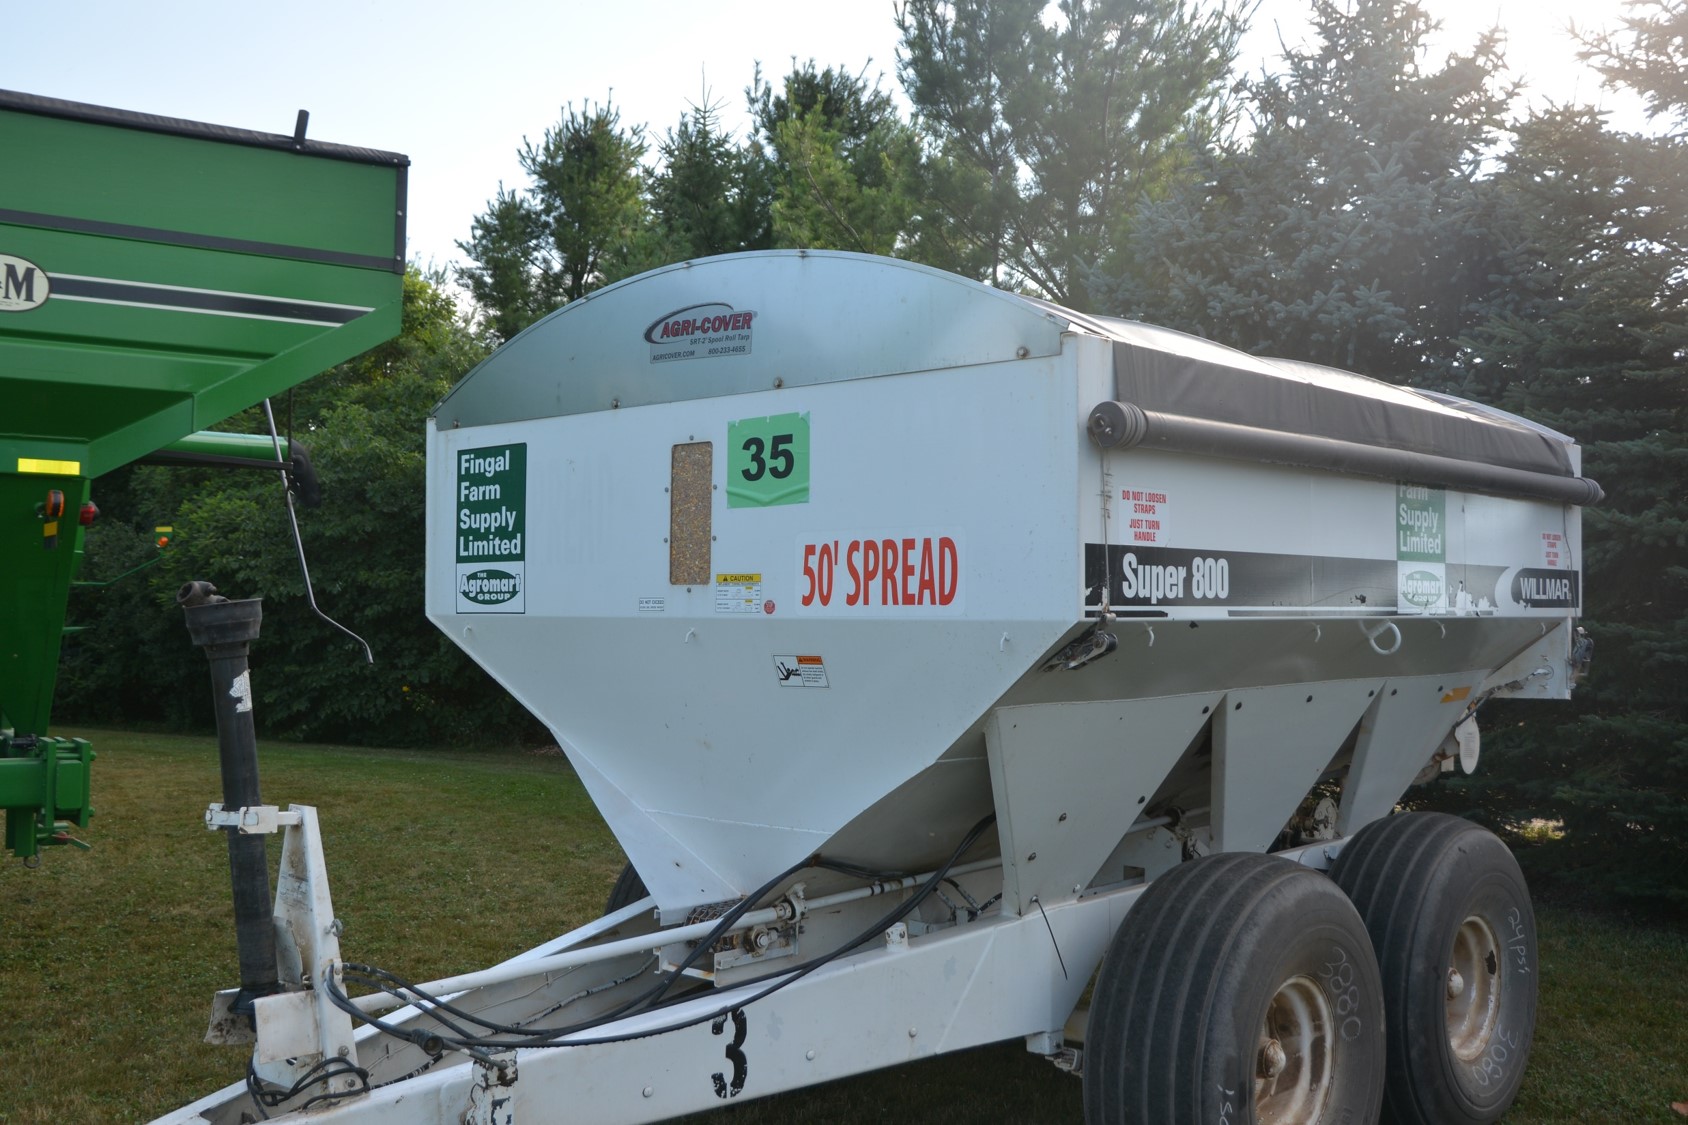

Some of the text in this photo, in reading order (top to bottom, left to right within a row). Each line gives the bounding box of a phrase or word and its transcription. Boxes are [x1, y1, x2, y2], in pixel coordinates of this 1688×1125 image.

[660, 312, 753, 339] AGRI-COVER
[708, 335, 723, 344] Spool
[725, 333, 736, 341] Roll
[737, 333, 750, 341] Tarp
[652, 350, 695, 361] AGRICOVER.COM
[460, 450, 510, 477] Fingal
[741, 433, 795, 482] 35
[460, 481, 500, 502] Farm
[1122, 490, 1167, 504] DO NOT LOOSEN
[459, 506, 516, 533] Supply
[1134, 503, 1156, 515] STRAPS
[1400, 503, 1439, 533] Supply
[1129, 518, 1160, 530] JUST TURN
[459, 533, 521, 556] Limited
[1134, 531, 1156, 542] HANDLE
[1400, 530, 1441, 554] Limited
[801, 537, 958, 607] 50' SPREAD
[1122, 552, 1229, 604] Super 800
[459, 574, 521, 598] Agromart
[1520, 577, 1571, 600] WILLMAR
[711, 1007, 748, 1099] 3
